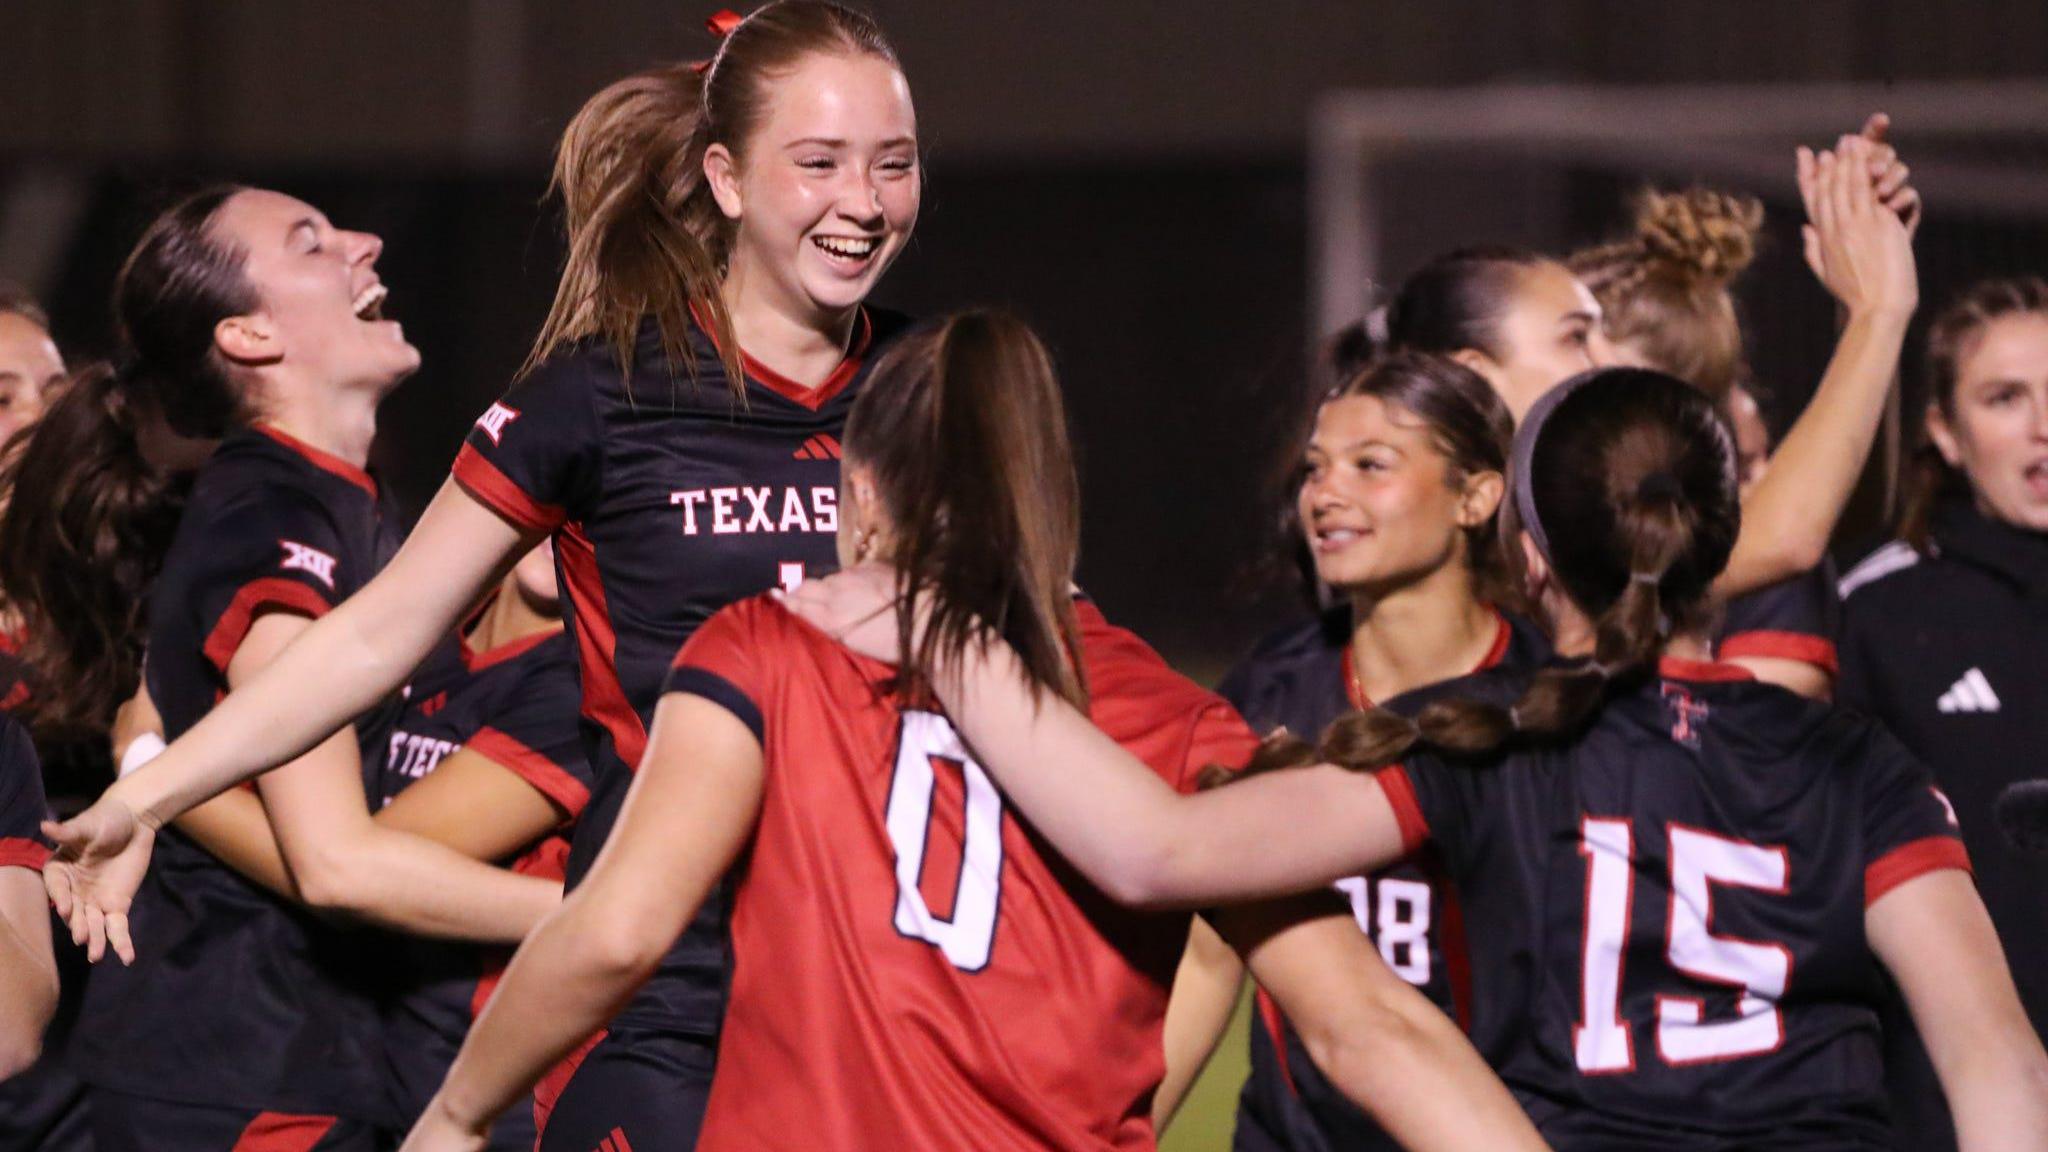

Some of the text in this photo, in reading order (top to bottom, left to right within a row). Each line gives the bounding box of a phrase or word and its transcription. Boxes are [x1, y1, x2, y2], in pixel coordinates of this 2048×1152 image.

[670, 486, 839, 535] TEXAS
[885, 709, 1002, 975] 0
[1573, 816, 1794, 1076] 15
